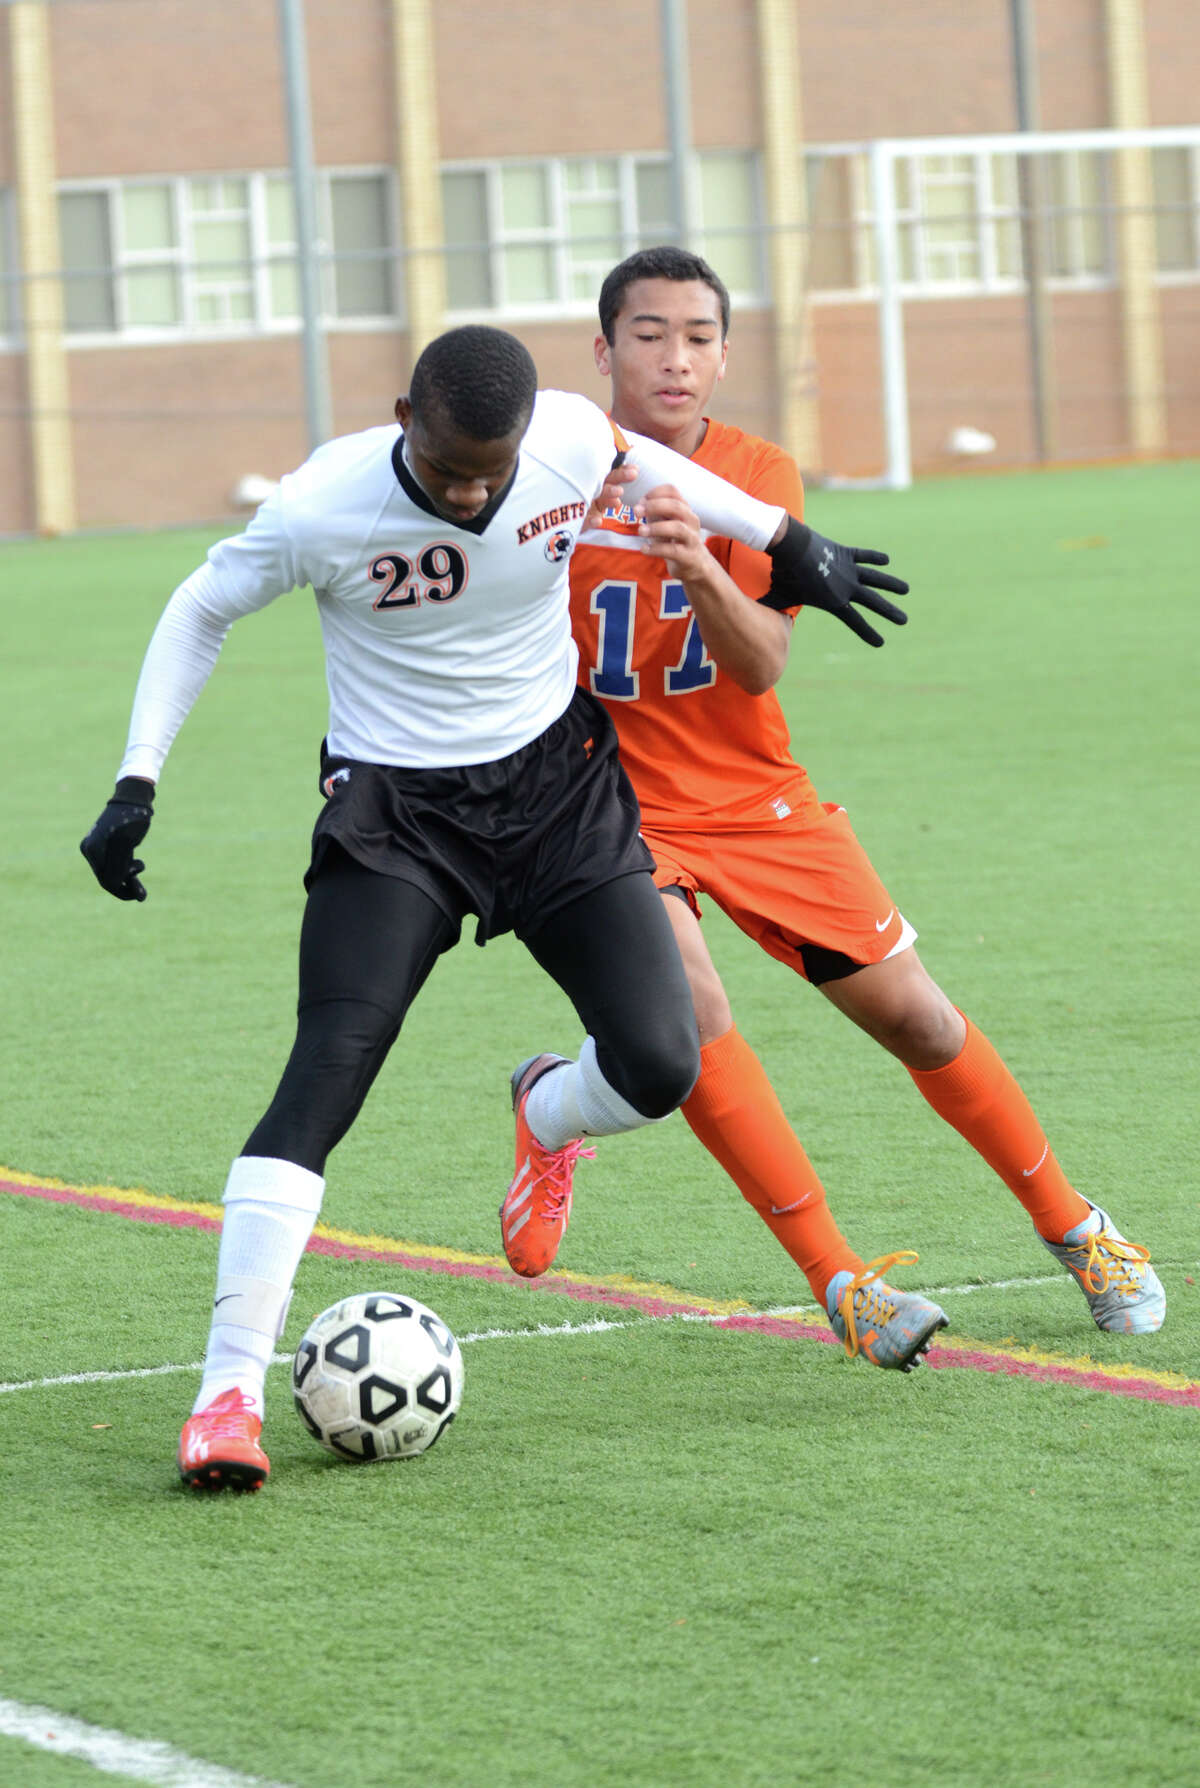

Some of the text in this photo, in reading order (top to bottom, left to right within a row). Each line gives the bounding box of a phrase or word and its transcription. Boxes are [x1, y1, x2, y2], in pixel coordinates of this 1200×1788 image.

[517, 501, 585, 546] KNIGHTS
[368, 540, 469, 612] 29
[589, 579, 717, 702] 17
